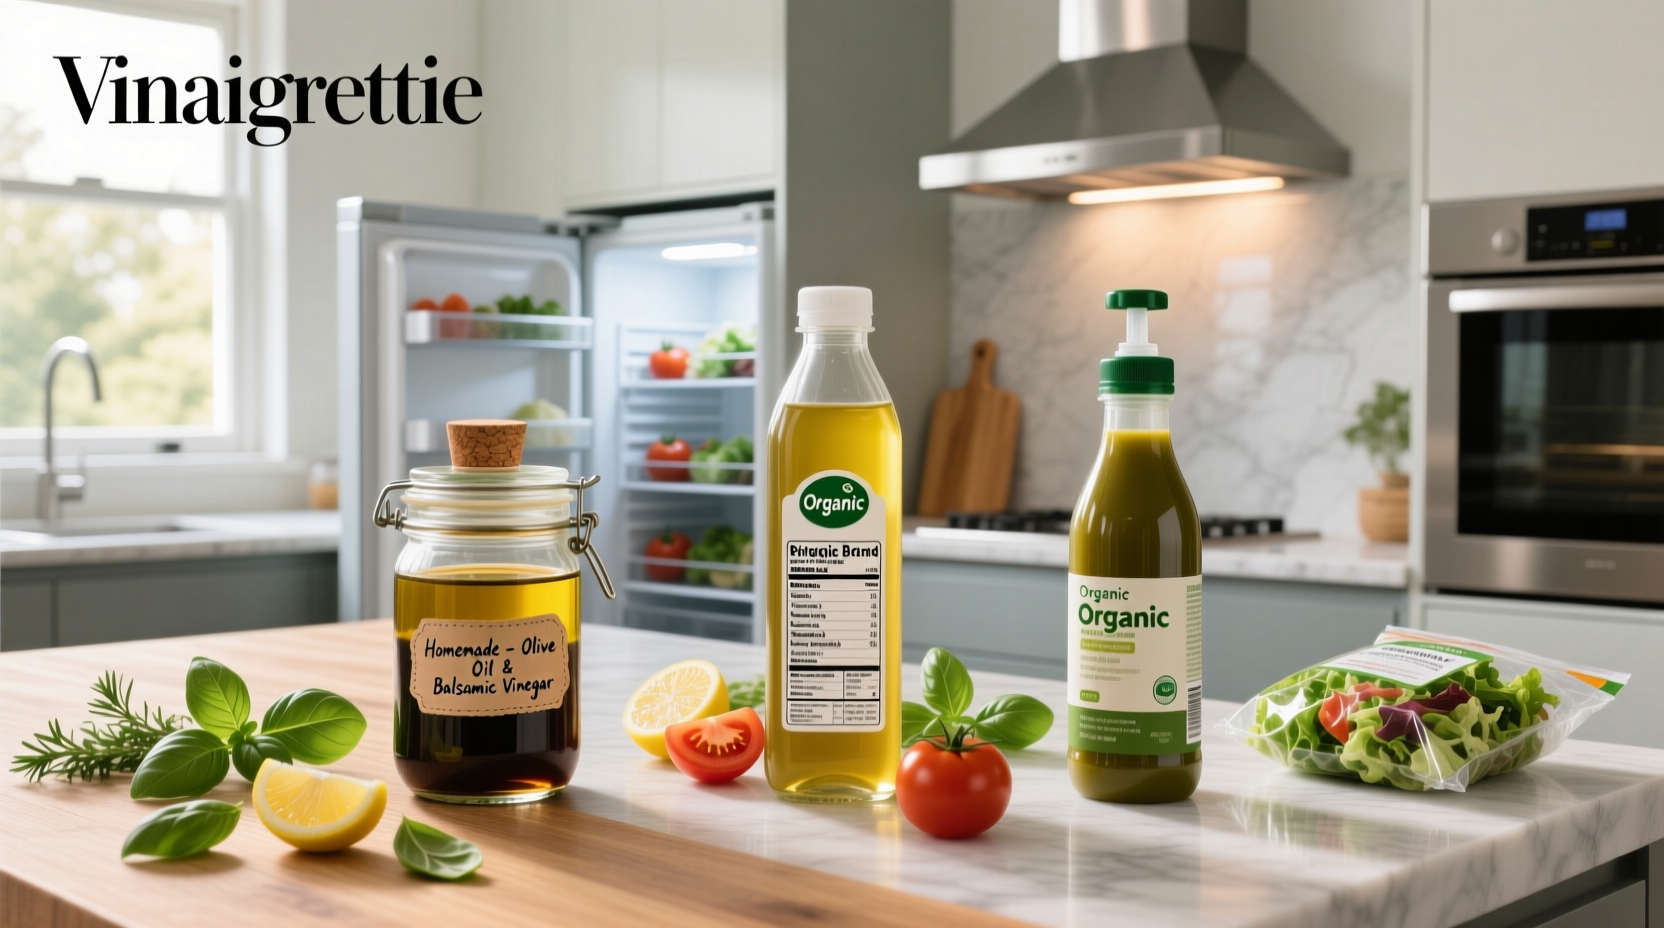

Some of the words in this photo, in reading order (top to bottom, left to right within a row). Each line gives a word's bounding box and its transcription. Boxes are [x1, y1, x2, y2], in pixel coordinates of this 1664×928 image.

[803, 493, 865, 516] Organic
[1079, 584, 1130, 603] Organic
[1078, 603, 1170, 634] Organic
[424, 637, 500, 658] Homemade
[521, 635, 556, 655] Olive
[472, 659, 494, 677] Oil
[502, 659, 513, 674] &
[433, 676, 497, 695] Balsamic
[502, 677, 555, 700] Vinegar
